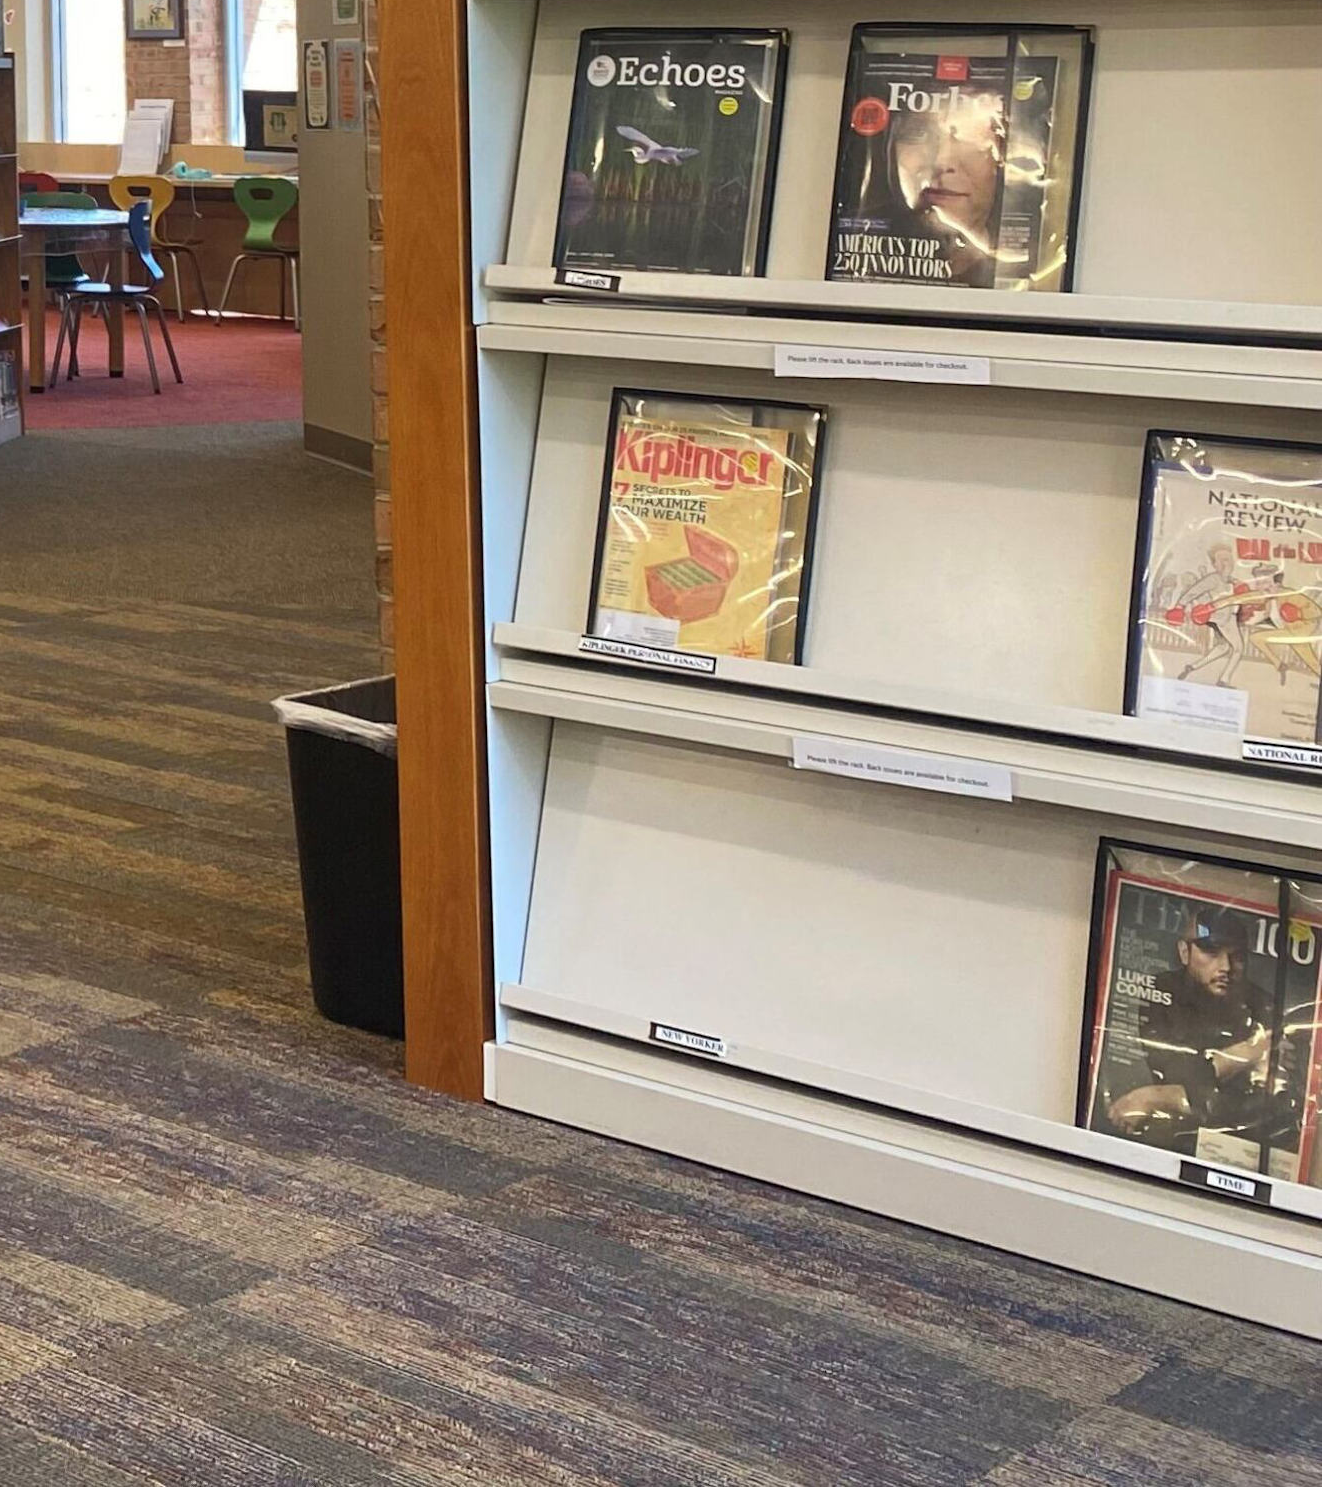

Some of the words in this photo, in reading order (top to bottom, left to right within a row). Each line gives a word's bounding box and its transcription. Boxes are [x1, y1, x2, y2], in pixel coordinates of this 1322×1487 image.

[617, 55, 746, 89] Echoes
[837, 233, 907, 256] AMERICA'S
[908, 237, 941, 259] TOP
[861, 254, 953, 279] INNOVATORS
[617, 428, 775, 490] Kiplinger
[633, 483, 677, 495] SECRETS
[679, 488, 691, 496] TO
[632, 493, 707, 513] MAXIMIZE
[1209, 490, 1322, 519] NATIONAL
[653, 508, 706, 524] WEALTH
[1223, 510, 1307, 534] REVIEW
[1248, 746, 1306, 762] NATIONAL
[1117, 967, 1157, 989] LUKE
[1115, 981, 1173, 1006] COMBS
[661, 1029, 682, 1040] NEW
[685, 1035, 724, 1052] YORKER
[1217, 1176, 1246, 1192] TIME
